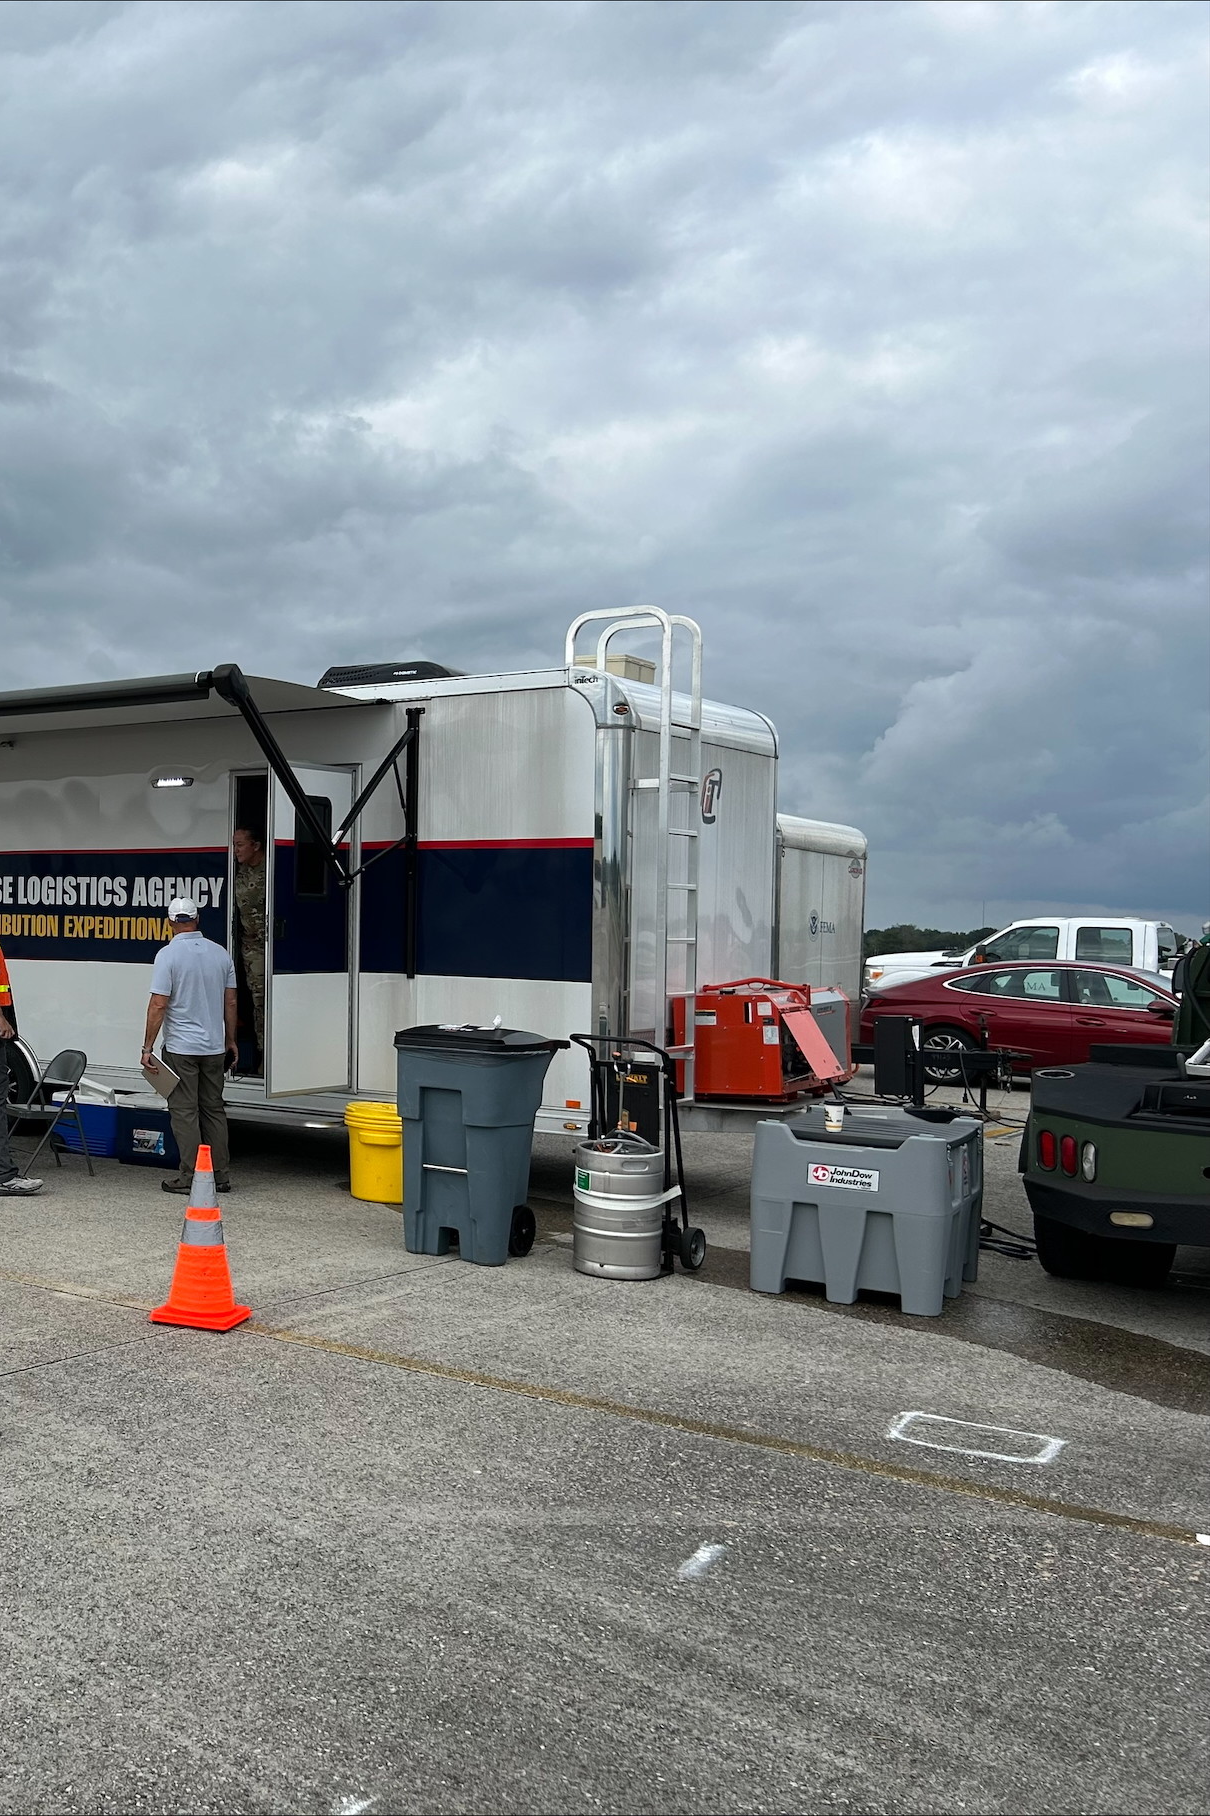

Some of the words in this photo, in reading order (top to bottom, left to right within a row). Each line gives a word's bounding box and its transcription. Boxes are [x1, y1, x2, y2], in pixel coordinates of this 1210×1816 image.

[17, 875, 128, 907] LOGISTICS
[131, 876, 225, 908] AGENCY
[63, 915, 174, 941] EXPEDITIONA
[819, 921, 836, 934] FEMA
[813, 1167, 829, 1180] JD
[830, 1168, 873, 1179] JohnDow
[830, 1175, 872, 1188] Industries
